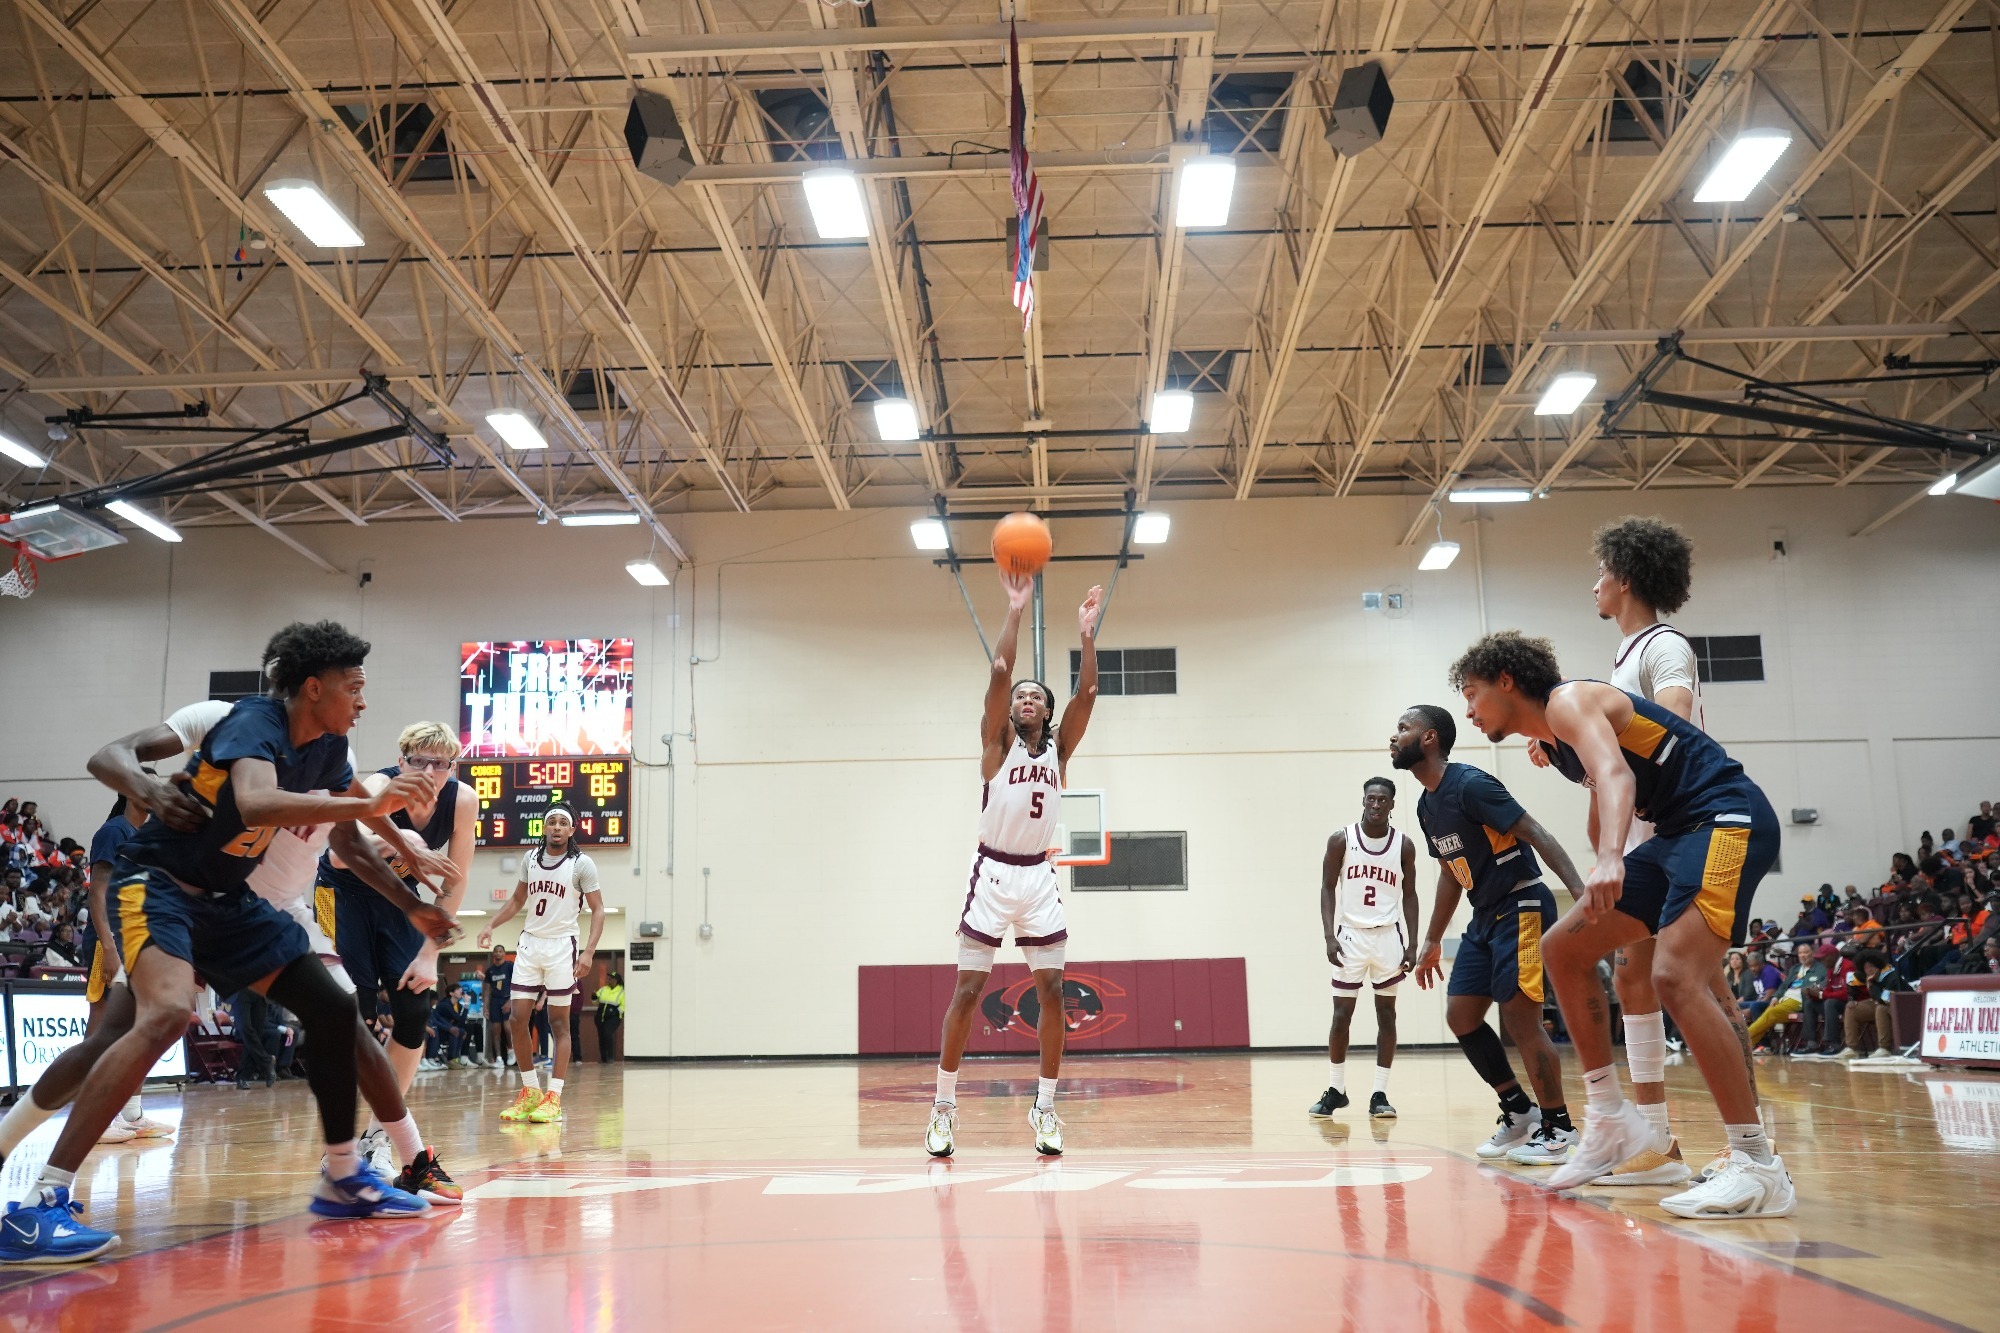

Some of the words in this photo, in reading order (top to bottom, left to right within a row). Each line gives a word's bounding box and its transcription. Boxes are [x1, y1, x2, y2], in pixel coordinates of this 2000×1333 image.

[511, 652, 584, 692] FREE
[529, 763, 570, 784] 5:08
[581, 763, 623, 773] CLAFLIN
[475, 777, 501, 798] 80
[591, 775, 616, 796] 86
[1009, 765, 1058, 792] CLAFLIN
[515, 794, 547, 803] PERIOD
[551, 789, 562, 802] 2
[1030, 792, 1044, 818] 5
[520, 812, 543, 820] PLAYE
[601, 810, 623, 818] FOULS
[493, 820, 504, 838] 3
[581, 818, 592, 836] 4
[608, 817, 619, 835] 8
[1347, 864, 1397, 887] CLAFLIN
[529, 880, 566, 899] CLAFLIN
[1364, 885, 1376, 907] 2
[536, 898, 547, 916] 0
[1927, 1007, 1974, 1033] CLAFLIN
